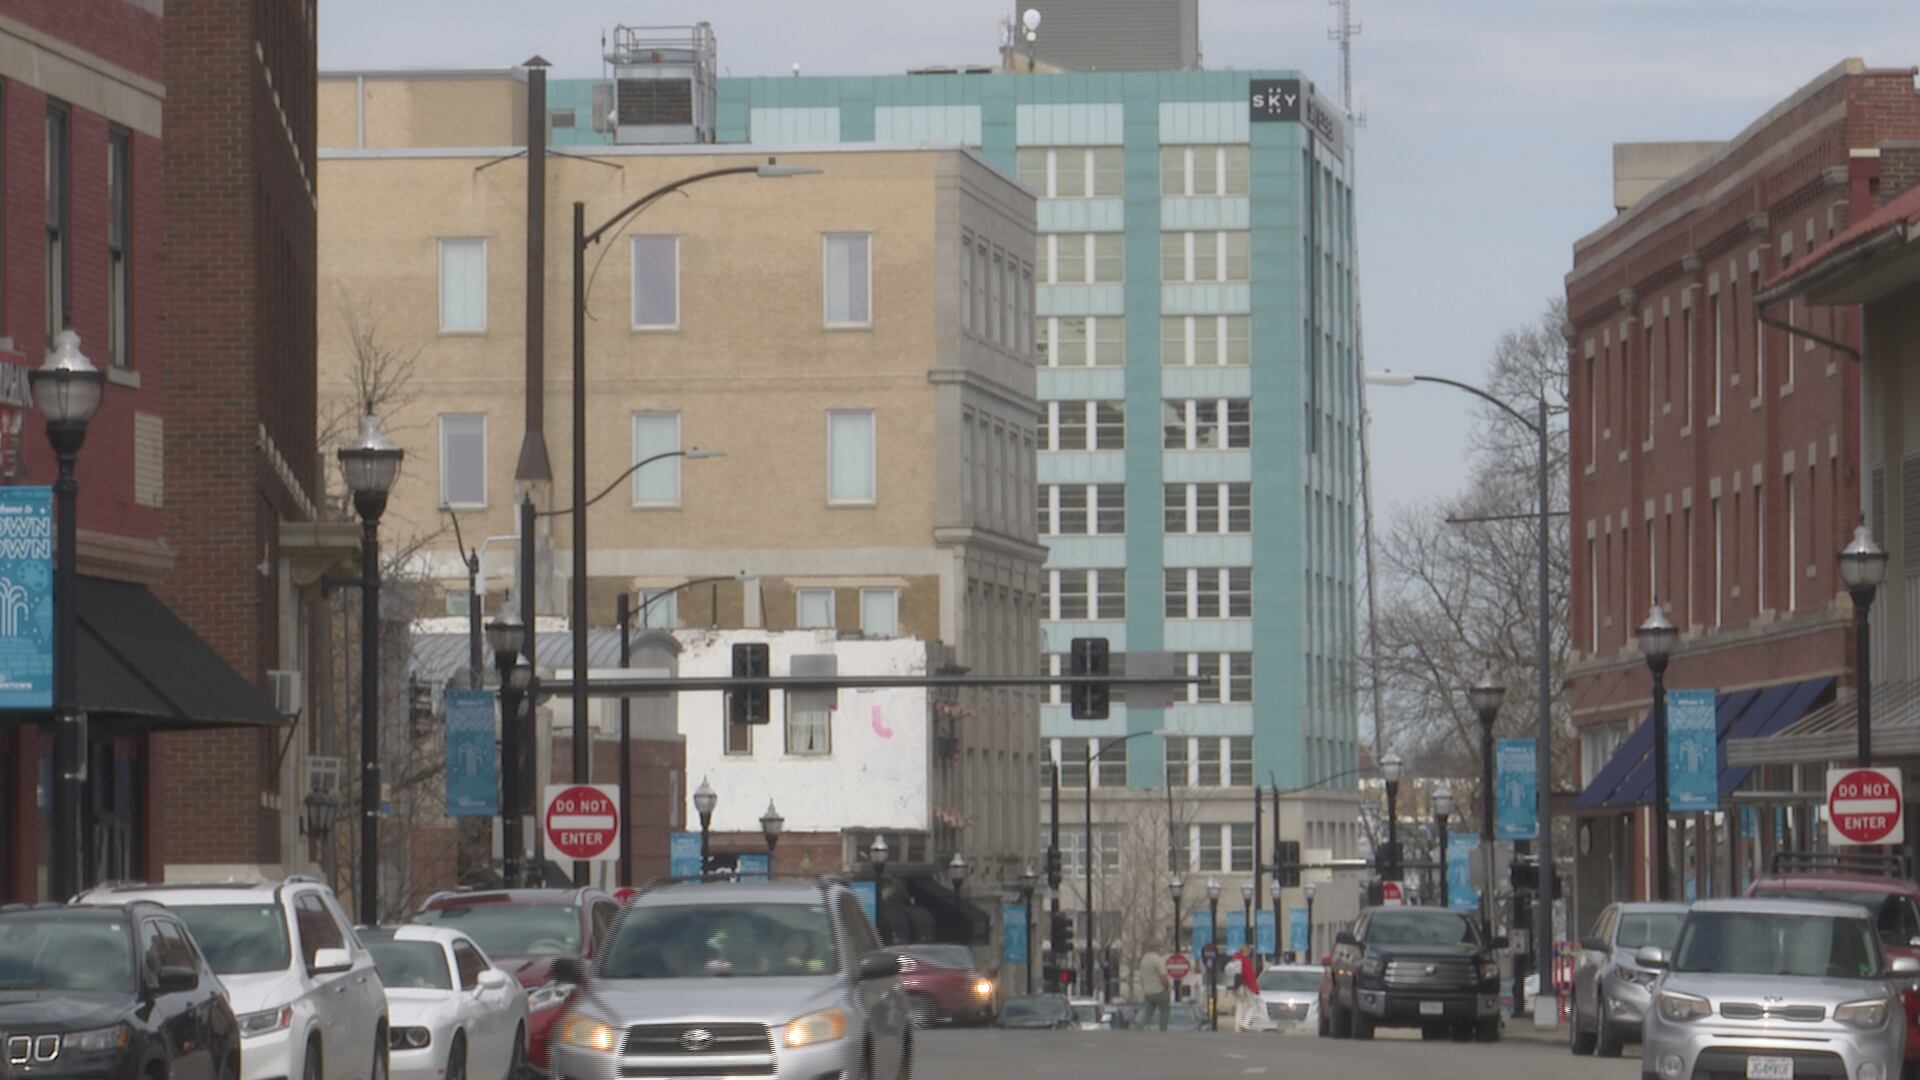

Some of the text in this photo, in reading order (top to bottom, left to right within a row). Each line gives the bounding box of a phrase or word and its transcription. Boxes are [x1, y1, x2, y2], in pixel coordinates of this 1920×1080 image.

[1252, 94, 1297, 108] SKY
[0, 538, 51, 559] WN
[1838, 783, 1890, 797] DO NOT
[555, 800, 608, 813] DO NOT
[1844, 816, 1887, 830] ENTER
[561, 832, 603, 846] ENTER
